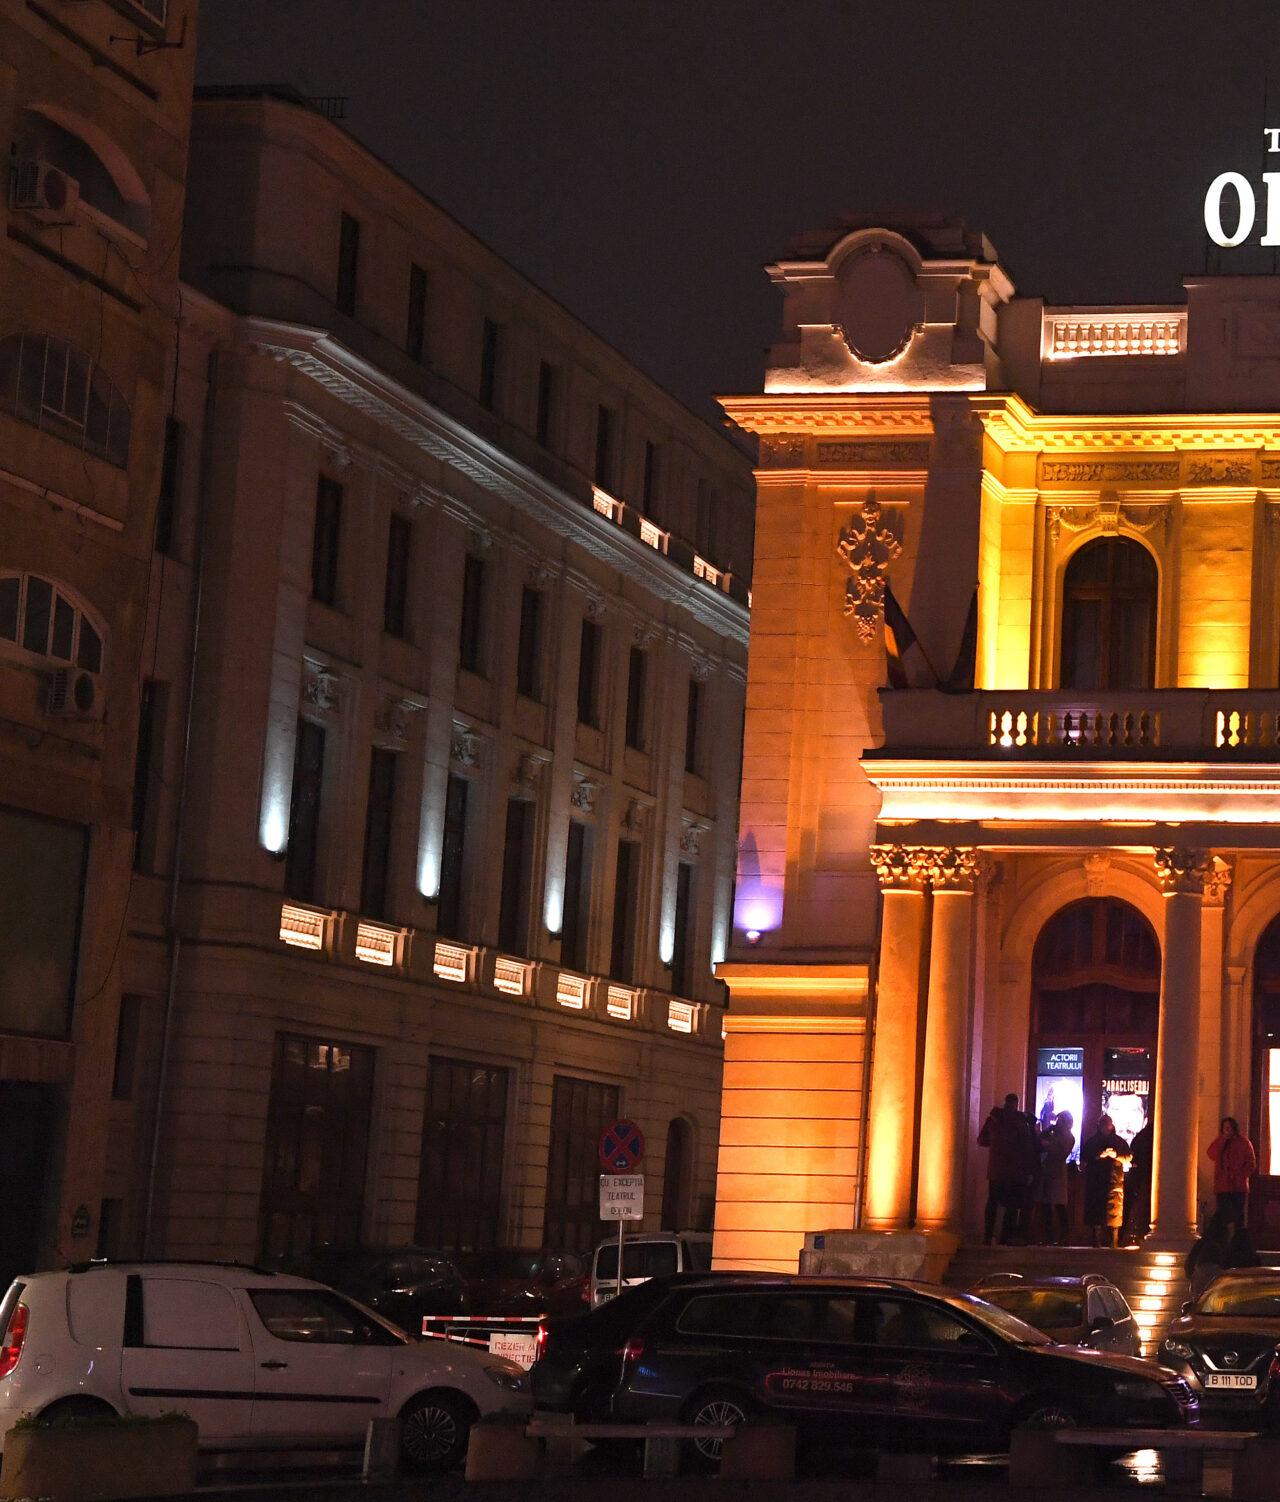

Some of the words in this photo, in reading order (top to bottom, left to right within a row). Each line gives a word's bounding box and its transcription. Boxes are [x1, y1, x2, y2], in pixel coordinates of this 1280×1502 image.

[1050, 1053, 1078, 1061] ACTORII
[1046, 1062, 1082, 1070] TEATRULUI
[783, 1378, 809, 1390] 0742
[1211, 1375, 1218, 1384] B
[1222, 1375, 1231, 1385] 111
